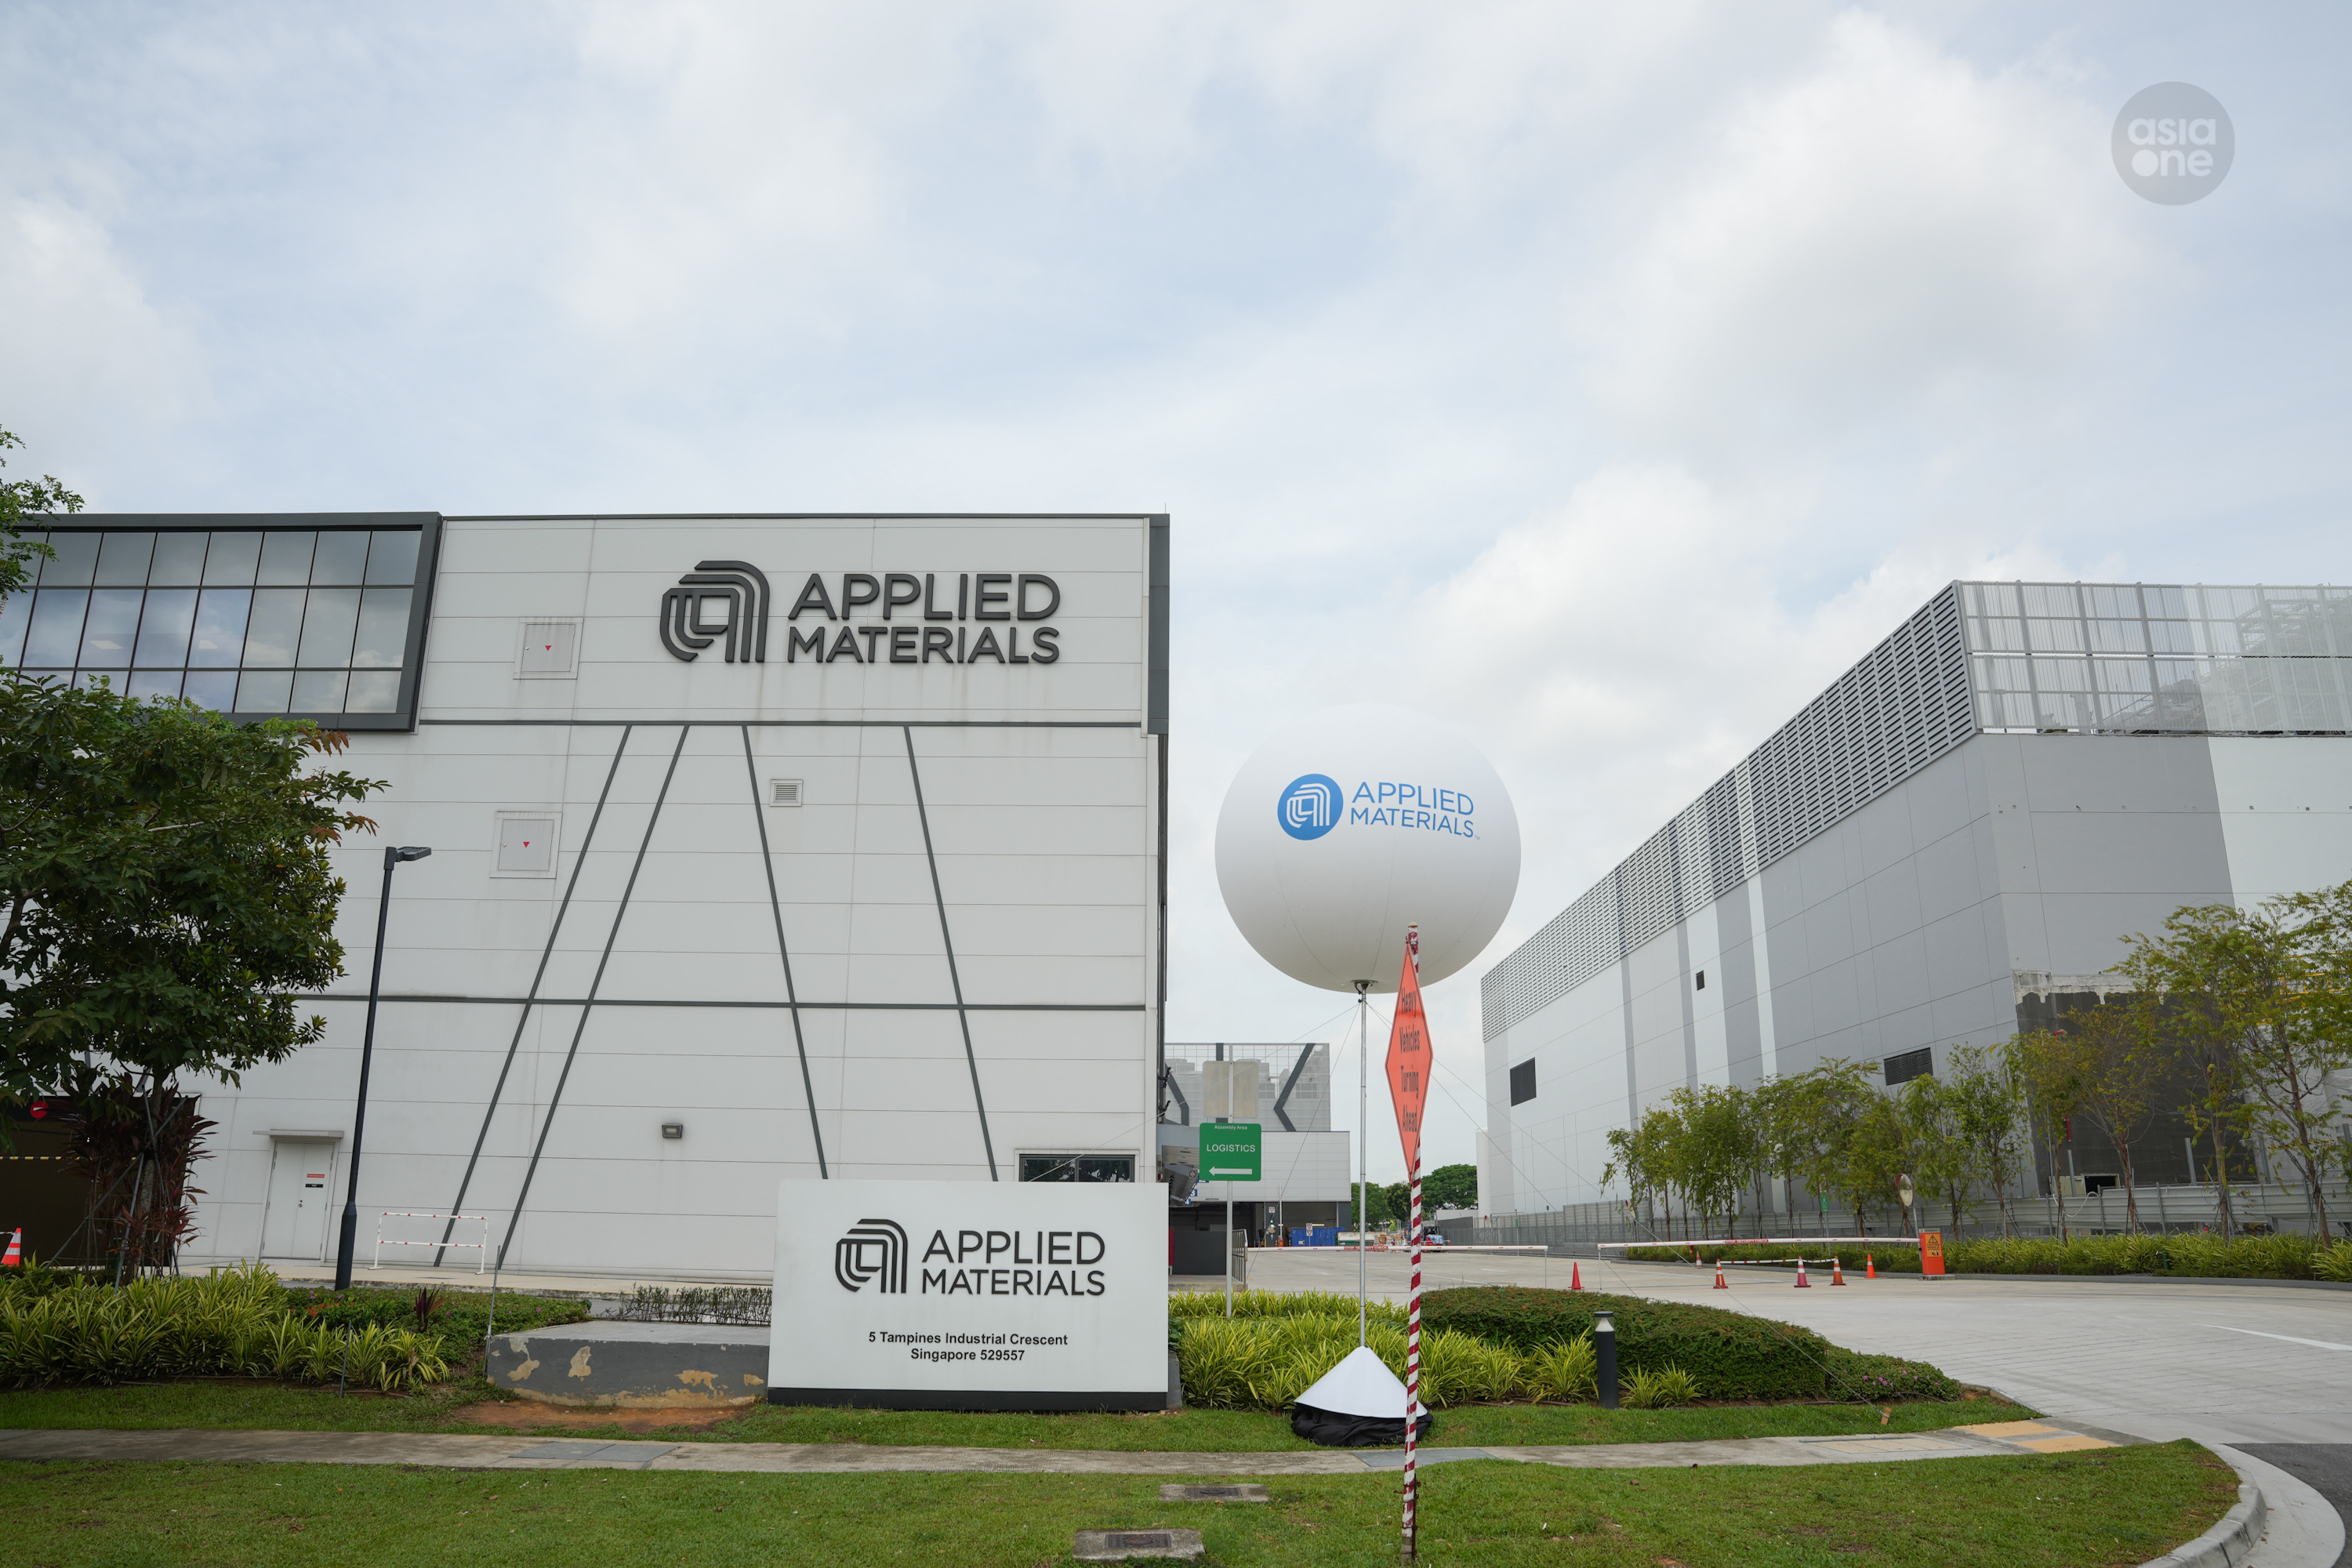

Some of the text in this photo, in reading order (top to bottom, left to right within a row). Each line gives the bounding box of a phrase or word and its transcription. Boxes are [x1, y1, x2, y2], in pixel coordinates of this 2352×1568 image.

[788, 573, 1061, 620] APPLIED
[787, 626, 1060, 663] MATERIALS
[1352, 781, 1474, 815] APPLIED
[1350, 807, 1474, 838] MATERIALS
[1401, 987, 1417, 1018] Heavy
[1399, 1023, 1420, 1054] Vehicles
[1400, 1064, 1418, 1099] Turning
[1402, 1104, 1417, 1132] Ahead
[1207, 1144, 1256, 1152] LOGISTICS
[921, 1229, 1105, 1265] APPLIED
[922, 1269, 1105, 1296] MATERIALS
[869, 1332, 1068, 1345] 5 Tampines Industrial Crescent
[911, 1348, 1025, 1362] Singapore 529557
